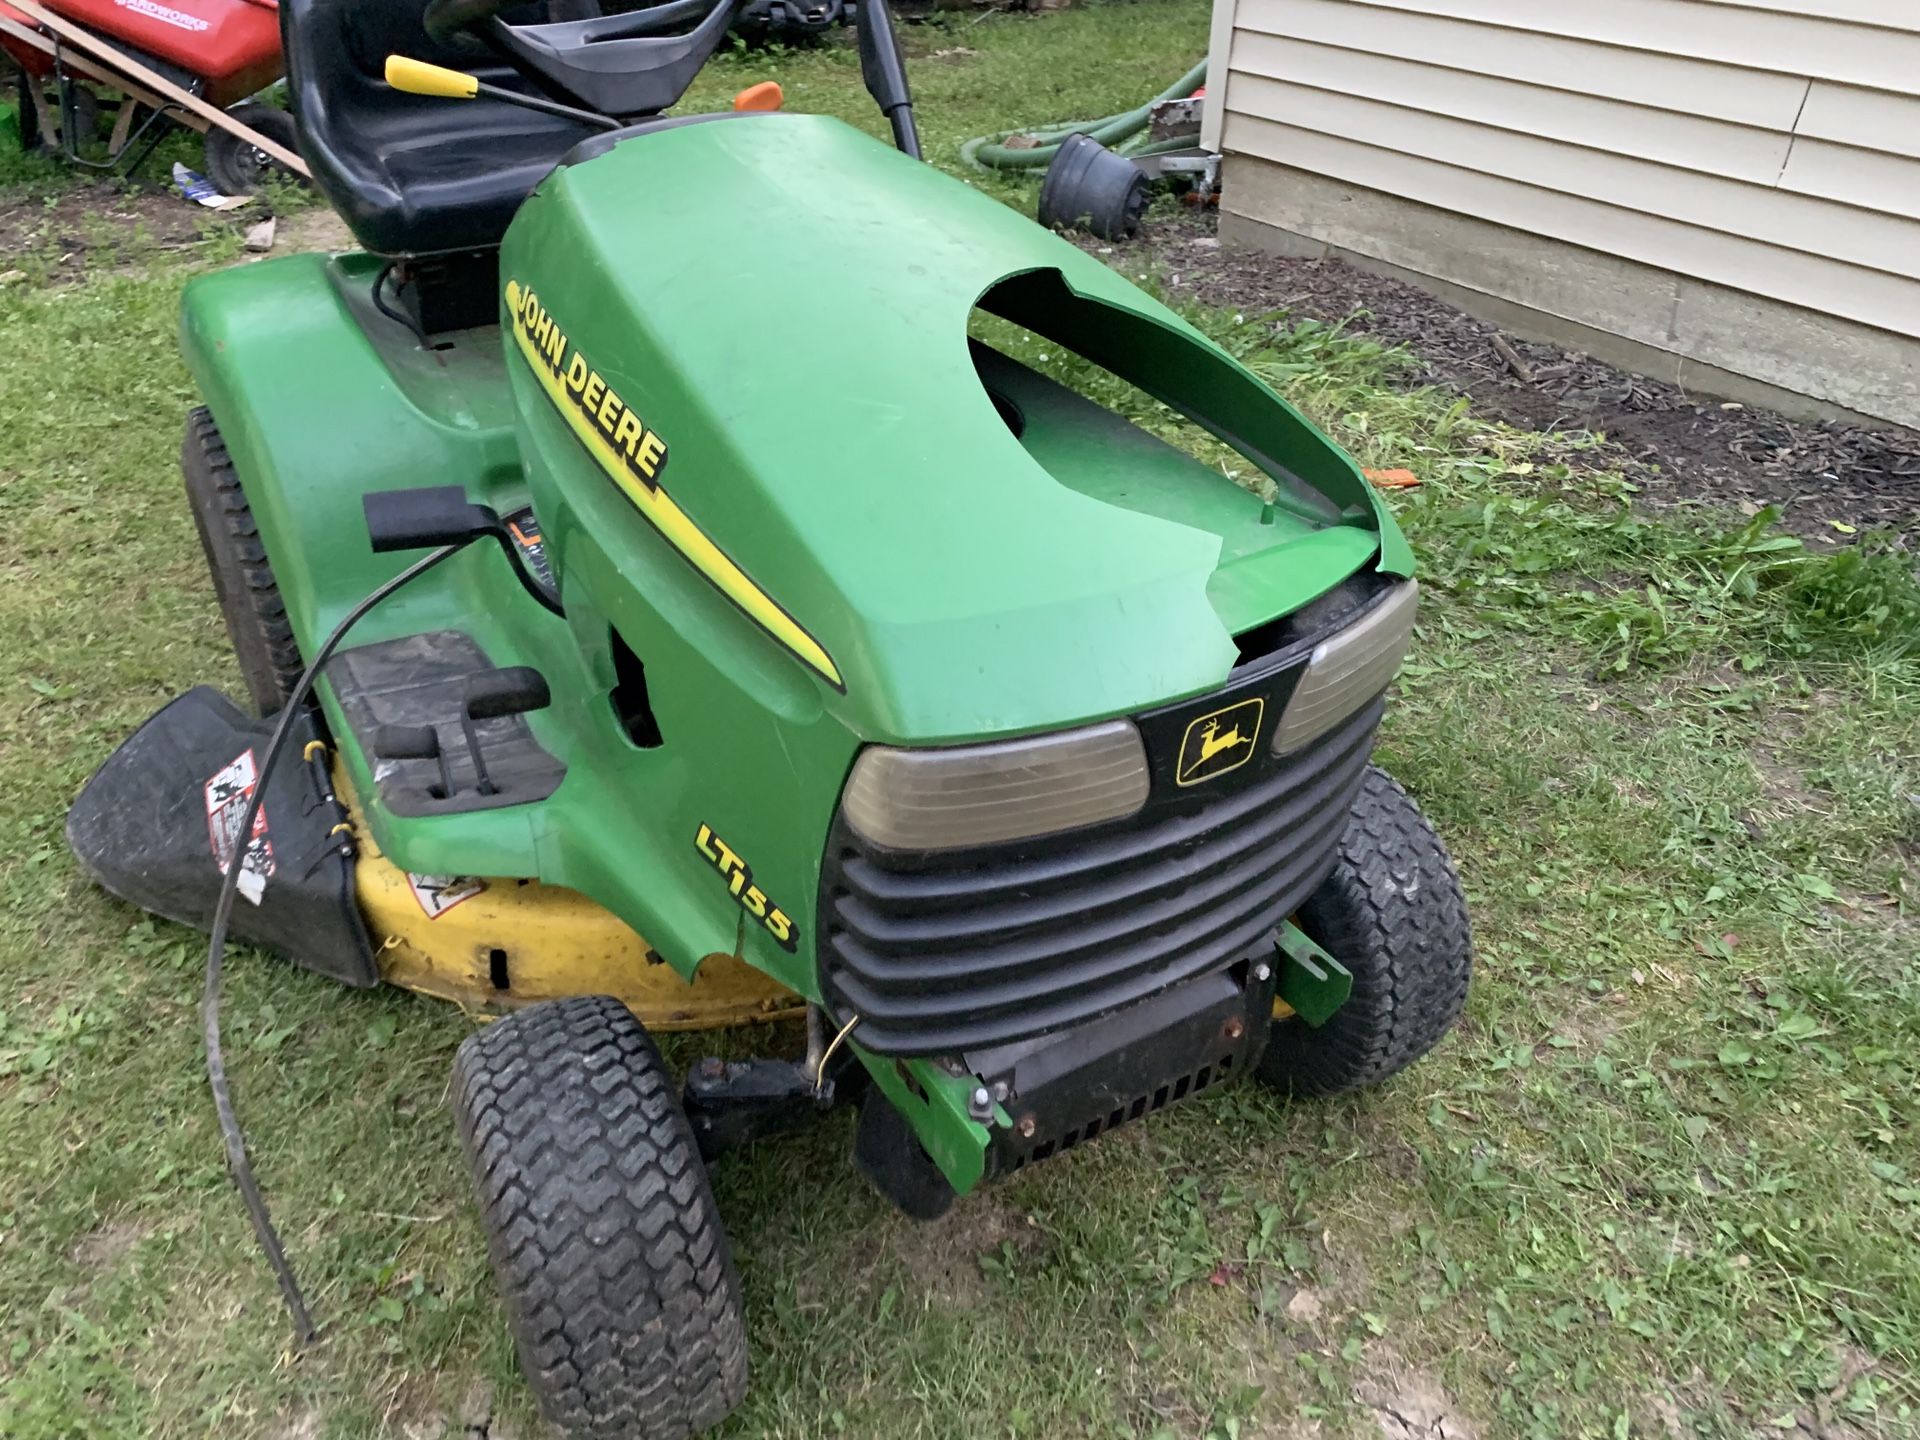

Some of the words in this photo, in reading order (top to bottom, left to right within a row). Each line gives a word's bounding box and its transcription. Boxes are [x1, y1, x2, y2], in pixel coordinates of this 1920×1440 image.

[517, 284, 567, 368] JOHN
[566, 351, 668, 479] DEERE
[695, 823, 793, 942] LT155
